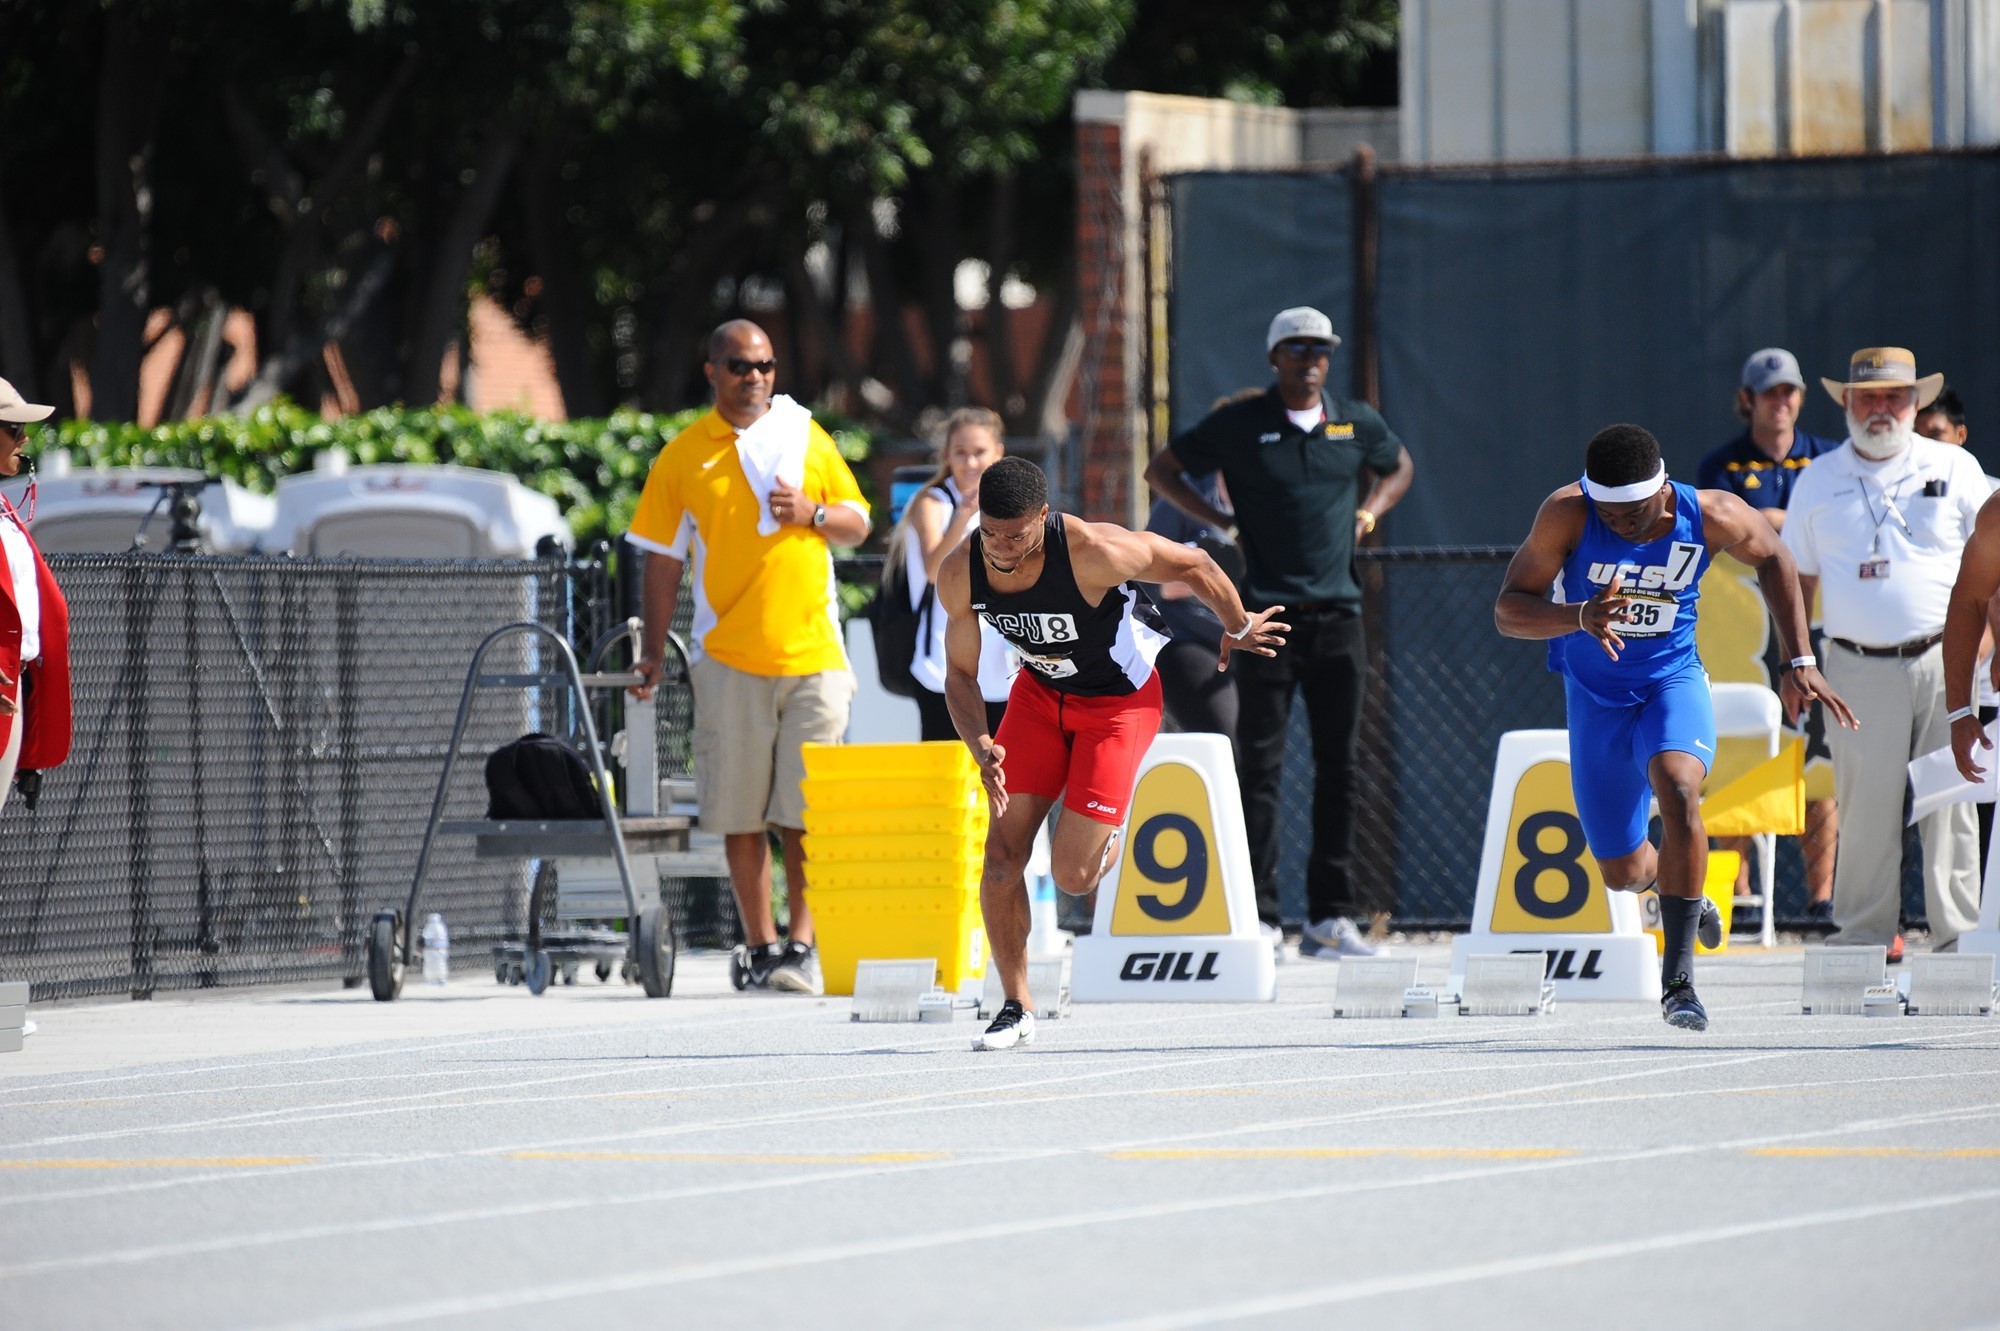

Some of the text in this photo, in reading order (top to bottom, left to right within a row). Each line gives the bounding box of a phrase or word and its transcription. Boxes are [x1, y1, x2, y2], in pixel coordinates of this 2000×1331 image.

[1673, 545, 1697, 582] 7
[1647, 590, 1661, 598] WEST
[1047, 616, 1070, 641] 8
[1133, 813, 1207, 922] 9
[1514, 810, 1590, 920] 8
[1119, 951, 1220, 981] GILL
[1509, 950, 1604, 980] ILL
